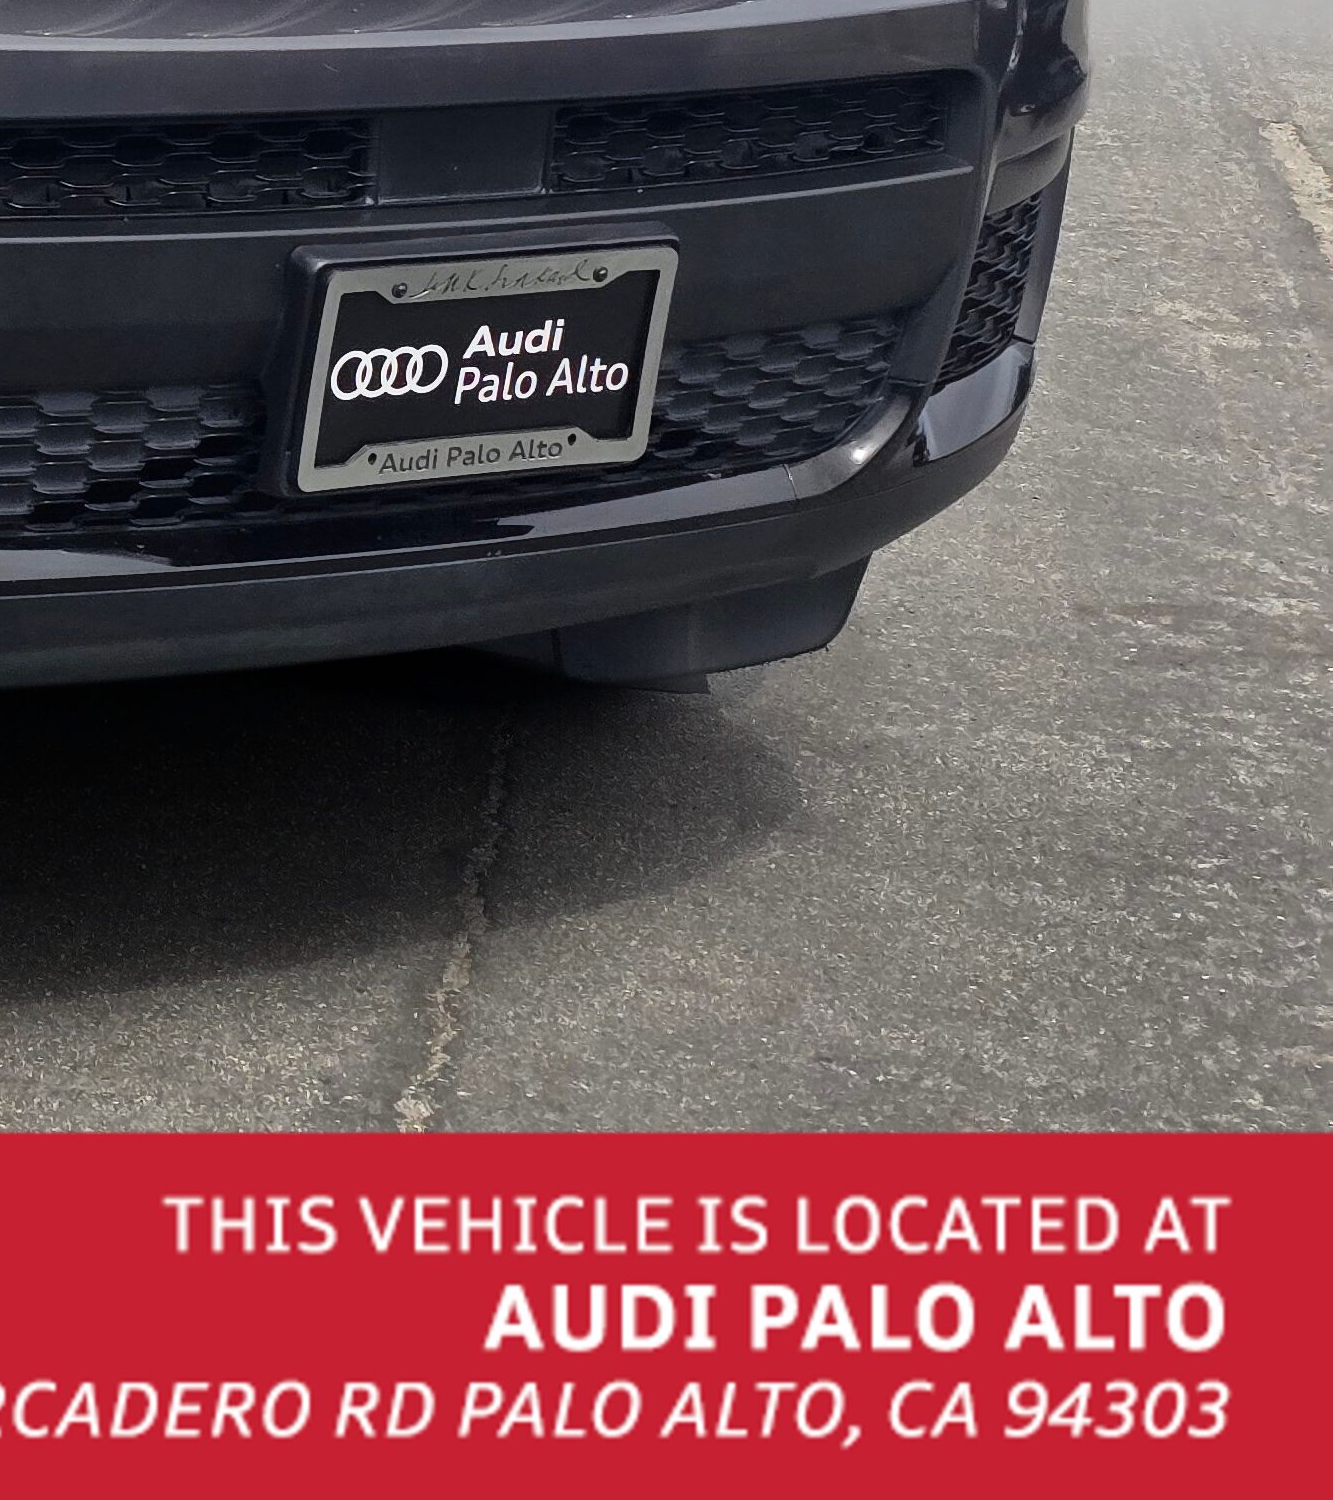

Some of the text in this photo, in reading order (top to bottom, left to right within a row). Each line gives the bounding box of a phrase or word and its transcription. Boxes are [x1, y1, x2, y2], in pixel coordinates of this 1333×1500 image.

[463, 318, 566, 359] Audi
[454, 354, 629, 405] Palo Alto
[378, 439, 564, 476] Audi Palo Alto
